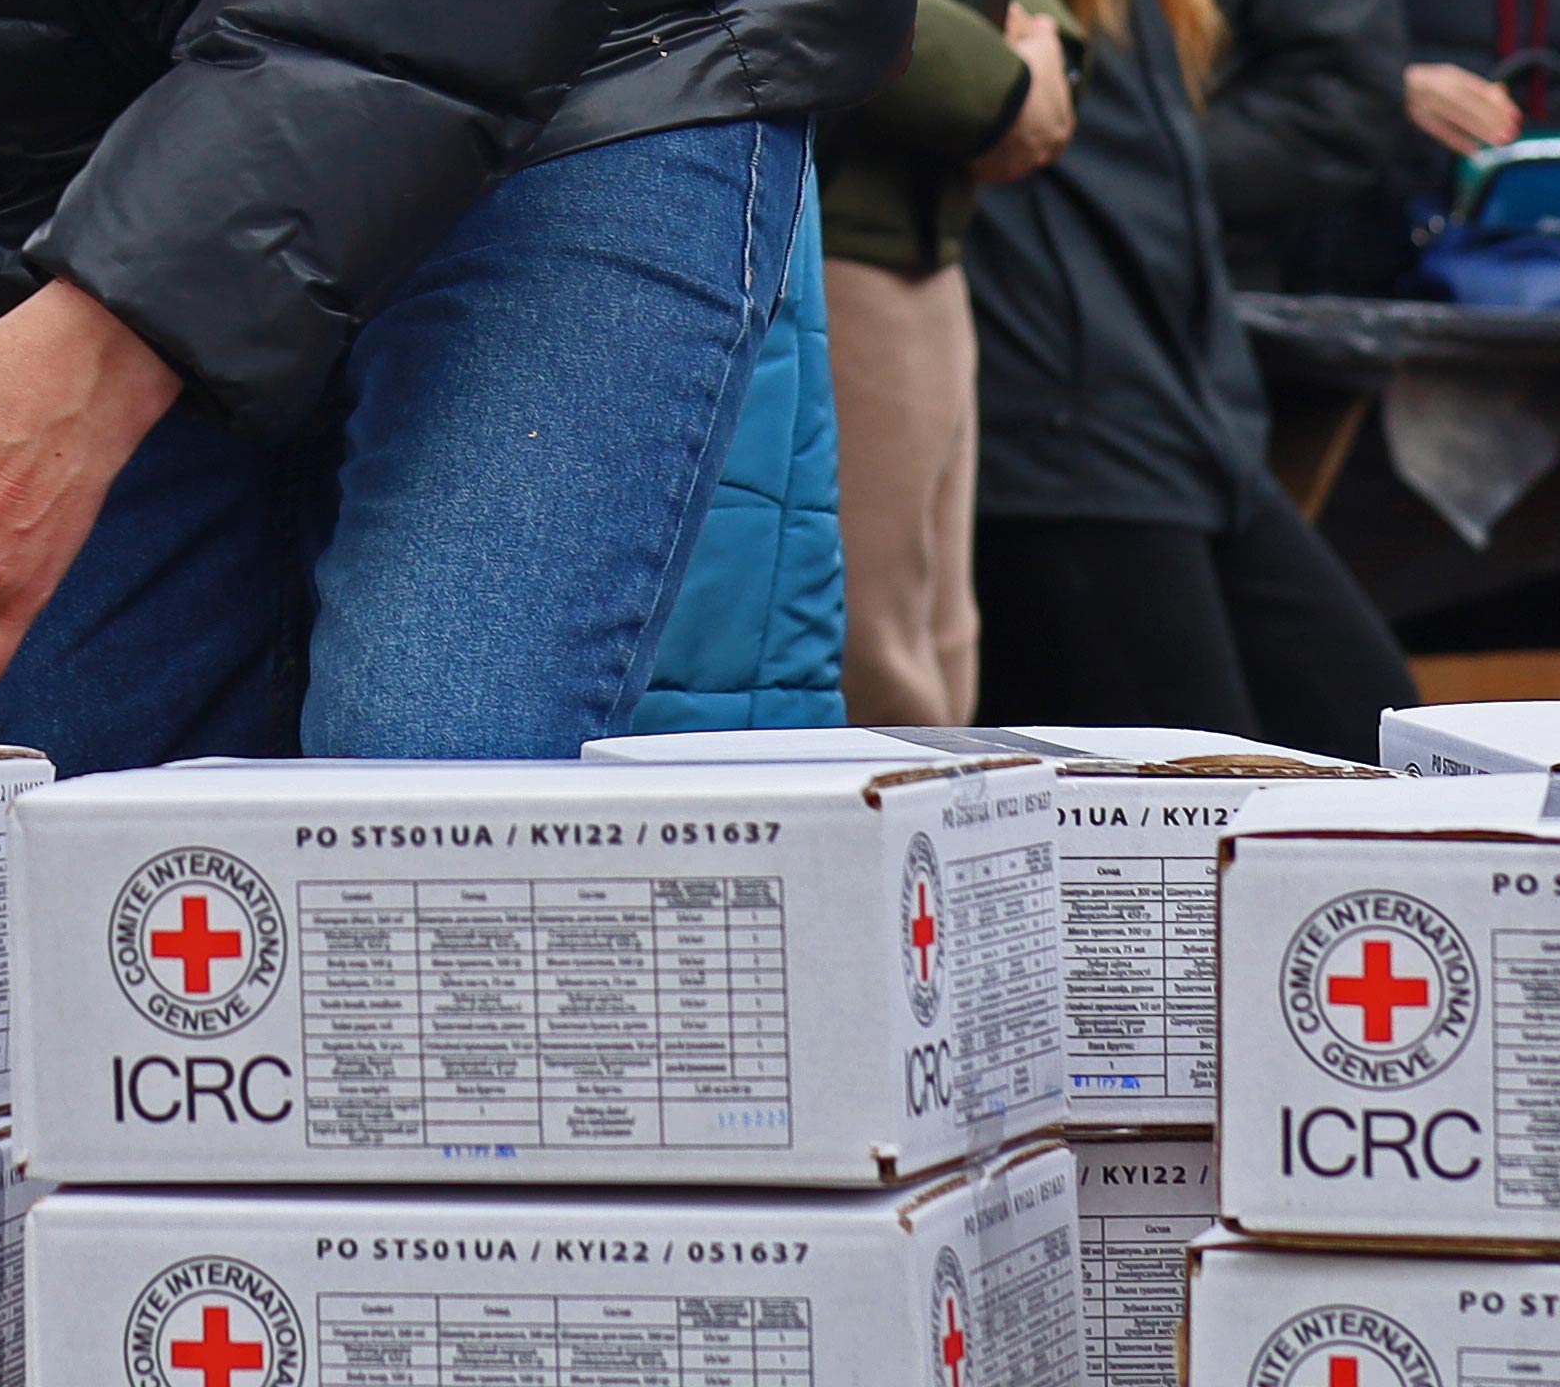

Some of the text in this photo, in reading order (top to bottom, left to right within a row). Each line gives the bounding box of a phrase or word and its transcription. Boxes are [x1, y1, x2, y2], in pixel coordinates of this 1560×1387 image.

[296, 822, 781, 849] PO STS01UA / KYI22 / 051637
[1163, 807, 1229, 827] KYI2
[1492, 873, 1539, 896] PO
[117, 883, 153, 986] COMITE
[147, 853, 280, 988] INTERNATIONAL
[1290, 924, 1331, 1035] COMITE
[1326, 897, 1471, 1040] INTERNATIONAL
[147, 993, 250, 1032] GENEVE
[1322, 1041, 1435, 1085] GENEVE
[112, 1054, 293, 1123] ICRC
[1280, 1106, 1482, 1181] ICRC
[1102, 1165, 1188, 1186] KYI22
[316, 1238, 808, 1264] PO STS01UA / KYI22 / 051637
[1459, 1290, 1505, 1315] PO
[165, 1263, 298, 1387] INTERNATIONA
[1293, 1311, 1433, 1387] INTERNATI
